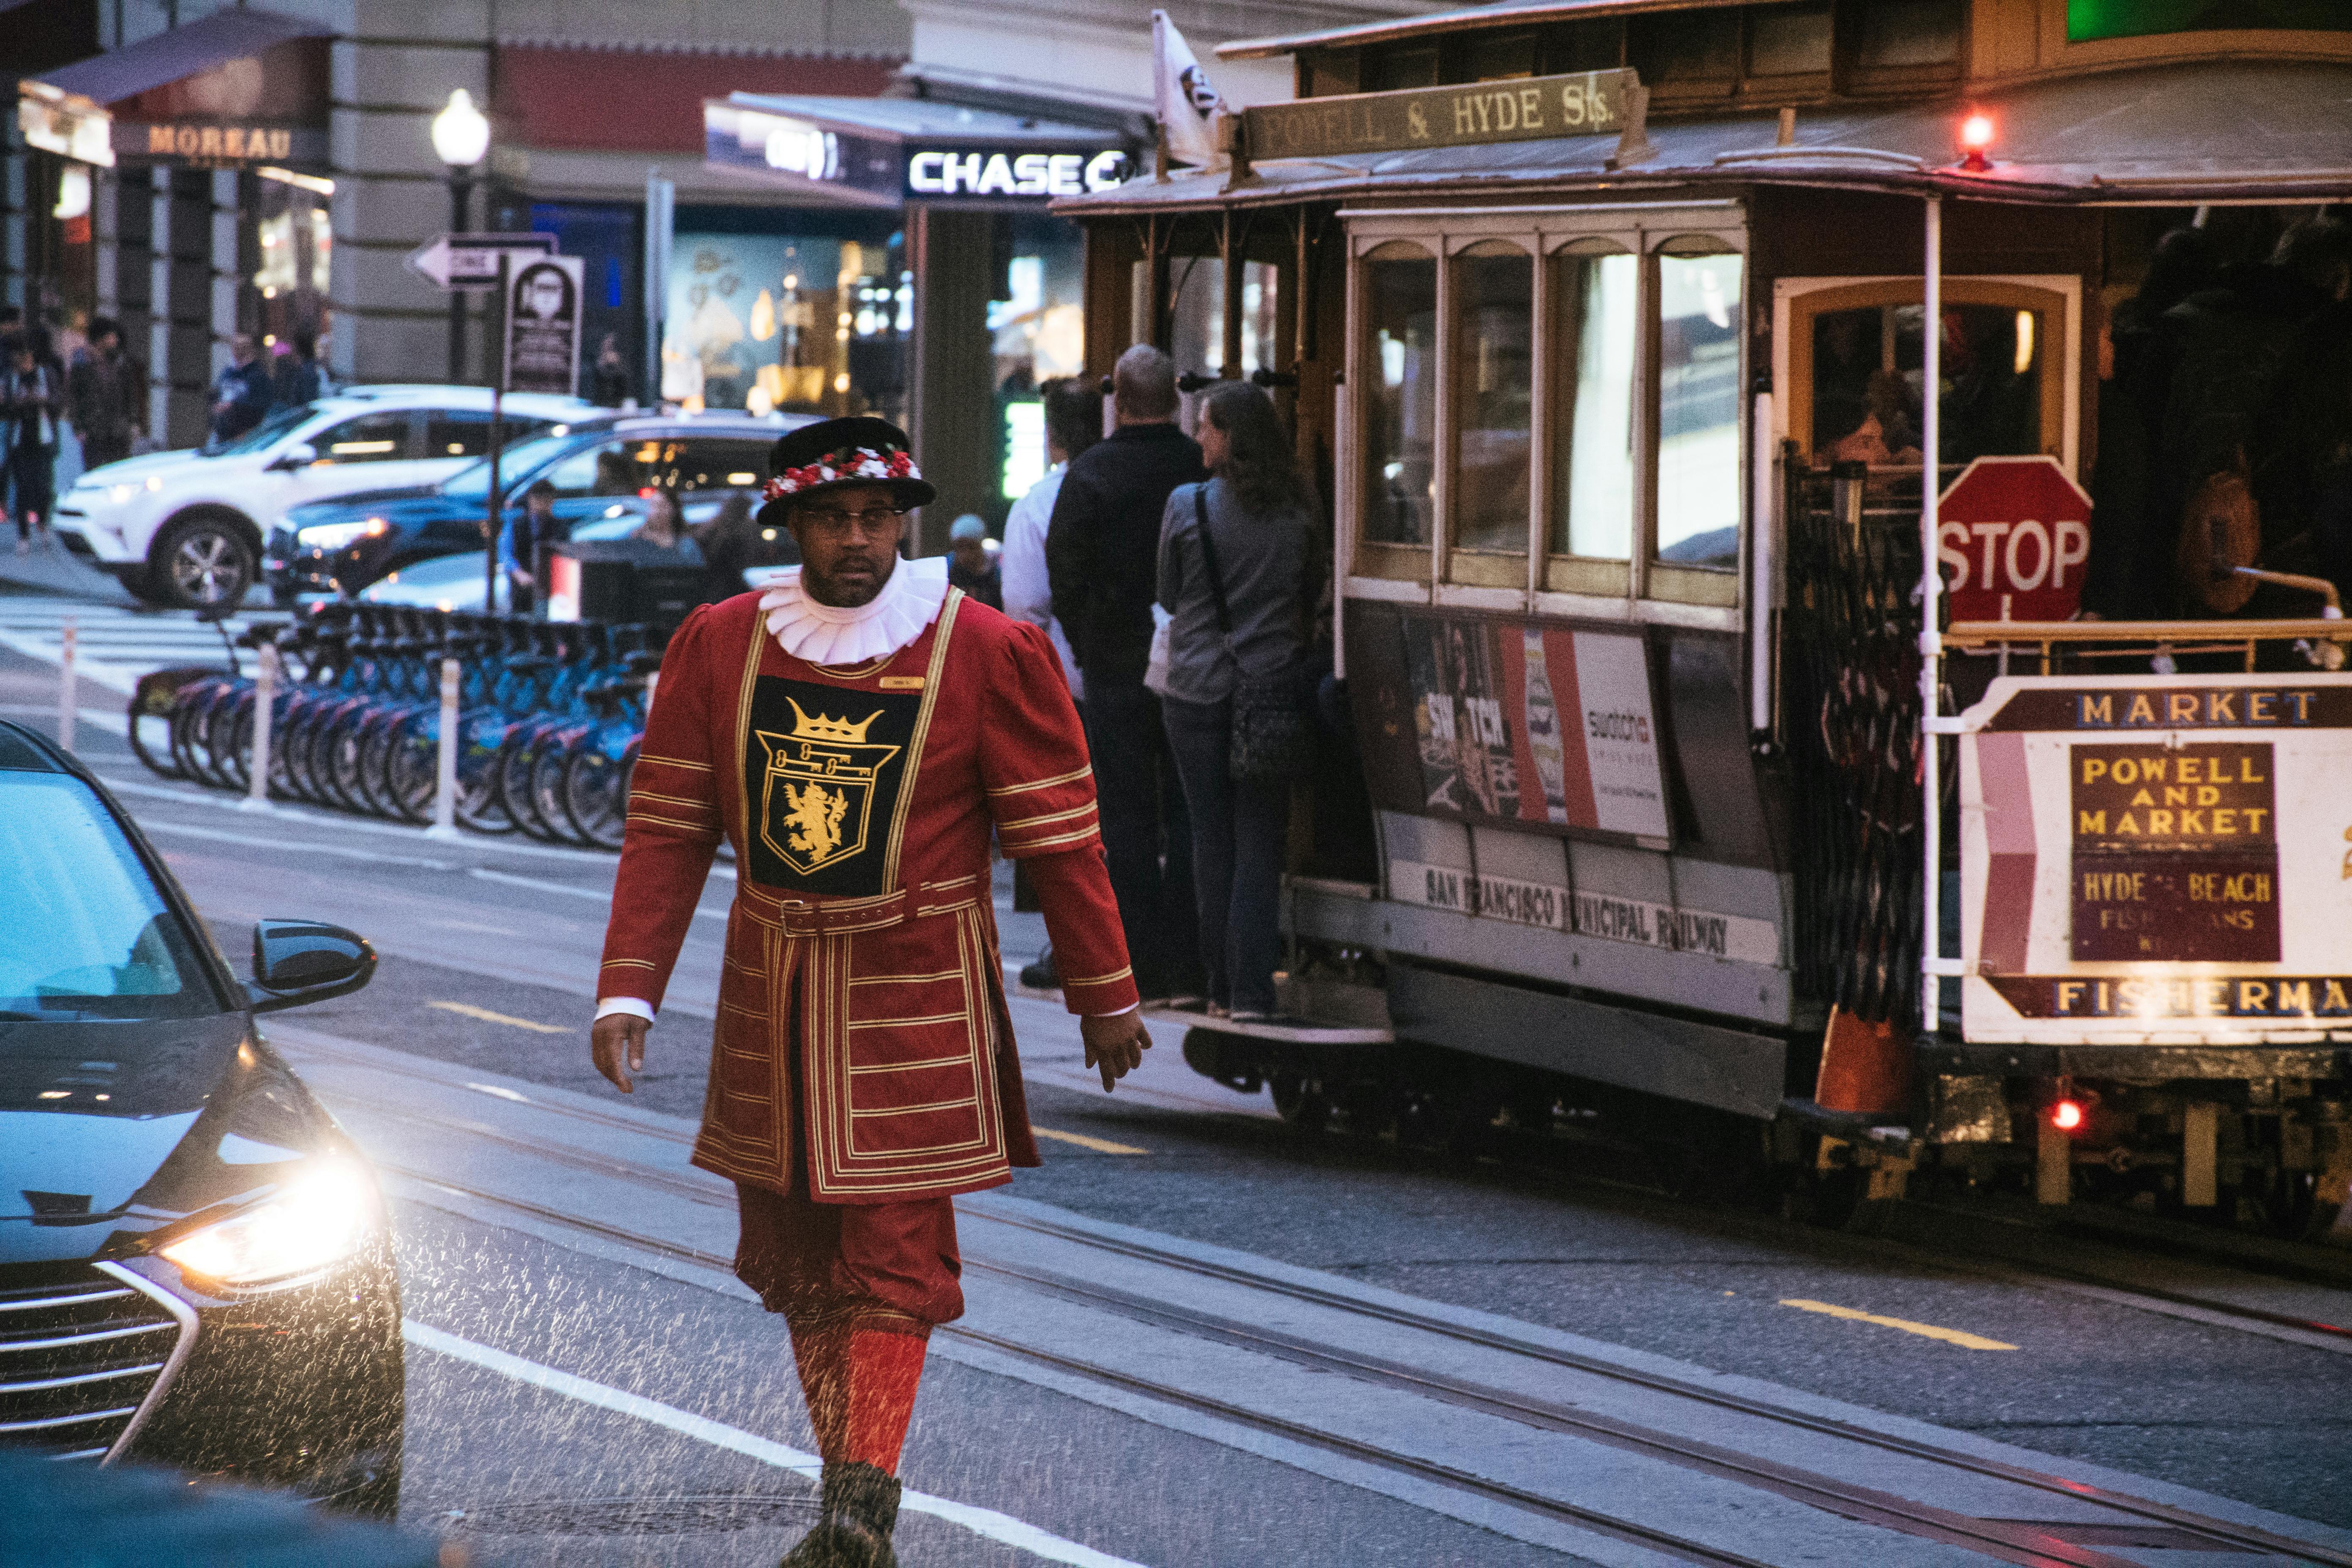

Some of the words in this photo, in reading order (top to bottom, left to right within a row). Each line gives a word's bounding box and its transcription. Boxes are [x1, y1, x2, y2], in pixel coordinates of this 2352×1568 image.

[1265, 106, 1386, 148] POWELL
[1407, 101, 1429, 139] &
[1454, 88, 1544, 135] HYDE
[149, 126, 291, 159] MOREAU
[909, 151, 1083, 195] CHASE
[1938, 519, 2091, 591] STOP
[2079, 691, 2317, 725] MARKET
[2082, 757, 2265, 785] POWELL
[2131, 785, 2221, 807] AND
[2080, 808, 2268, 836] MARKET
[1426, 868, 1459, 906] SAN
[1464, 876, 1554, 924] FANCISCO
[2083, 872, 2146, 902] HYDE
[2188, 872, 2271, 902] BEACH
[2055, 980, 2351, 1014] FISHERMA
